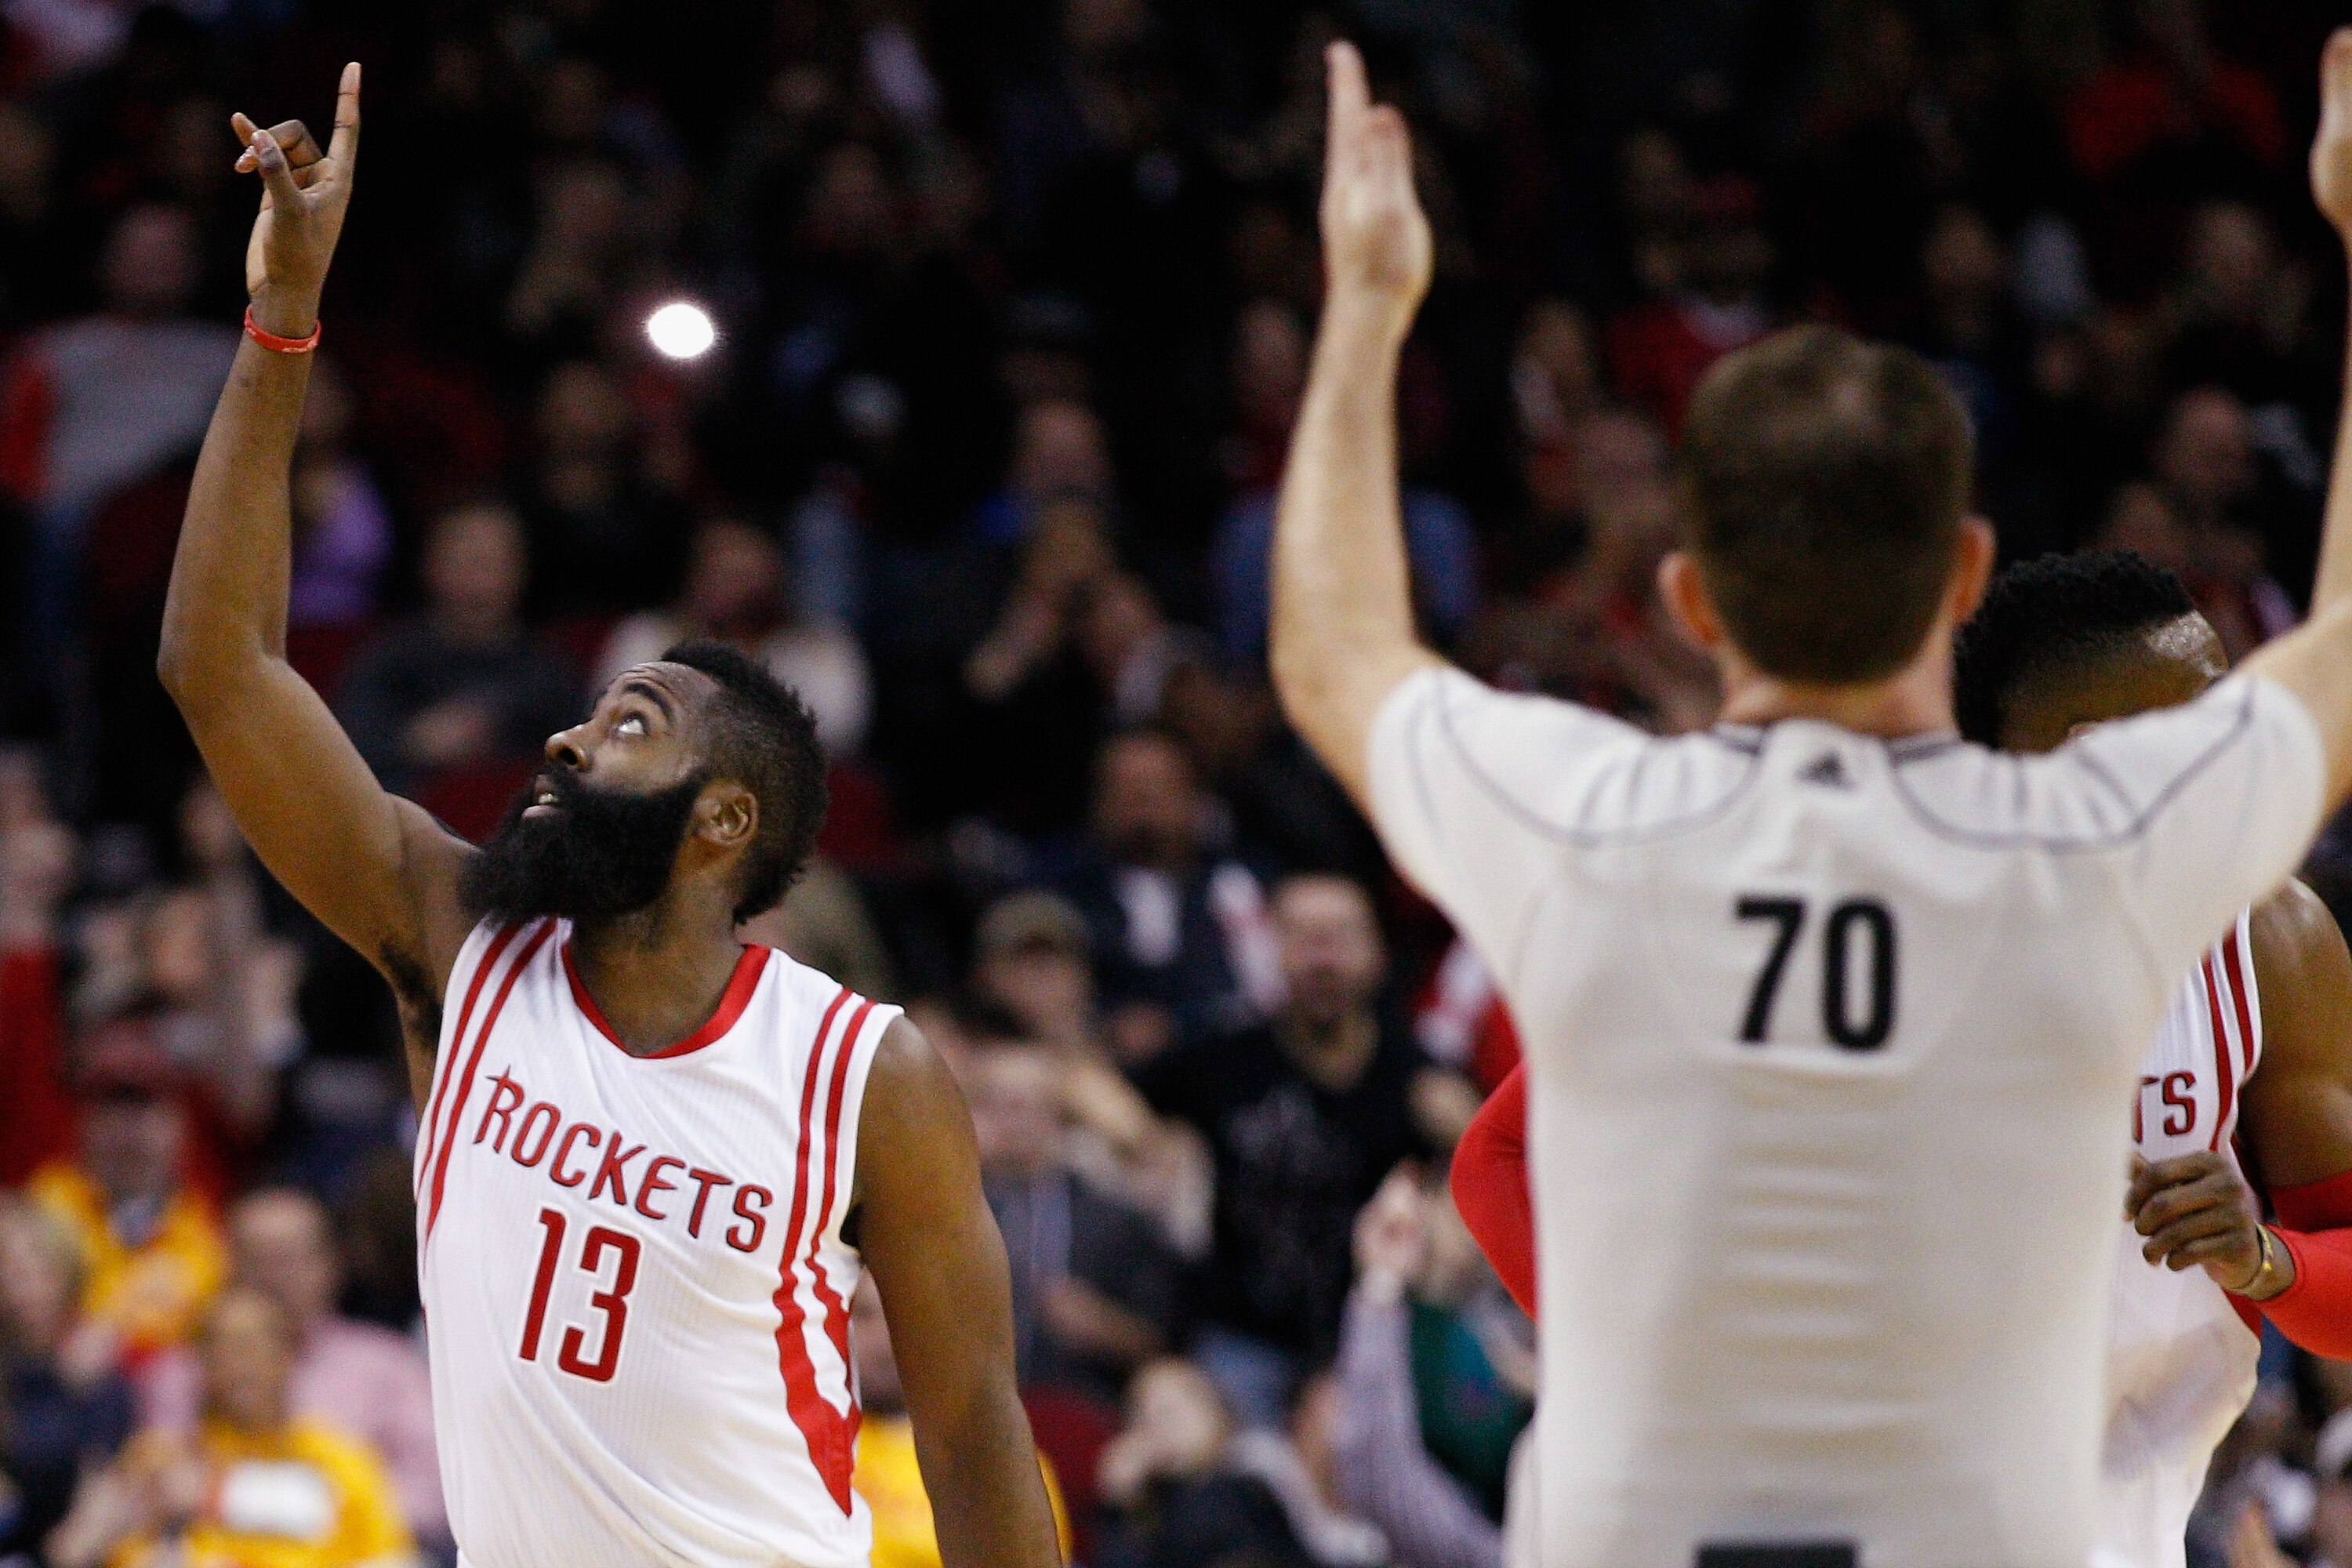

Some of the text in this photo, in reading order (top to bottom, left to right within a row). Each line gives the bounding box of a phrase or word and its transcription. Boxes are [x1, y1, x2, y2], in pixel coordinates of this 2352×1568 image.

[1733, 895, 1899, 1052] 70
[472, 1064, 774, 1253] ROCKETS
[518, 1206, 641, 1384] 13
